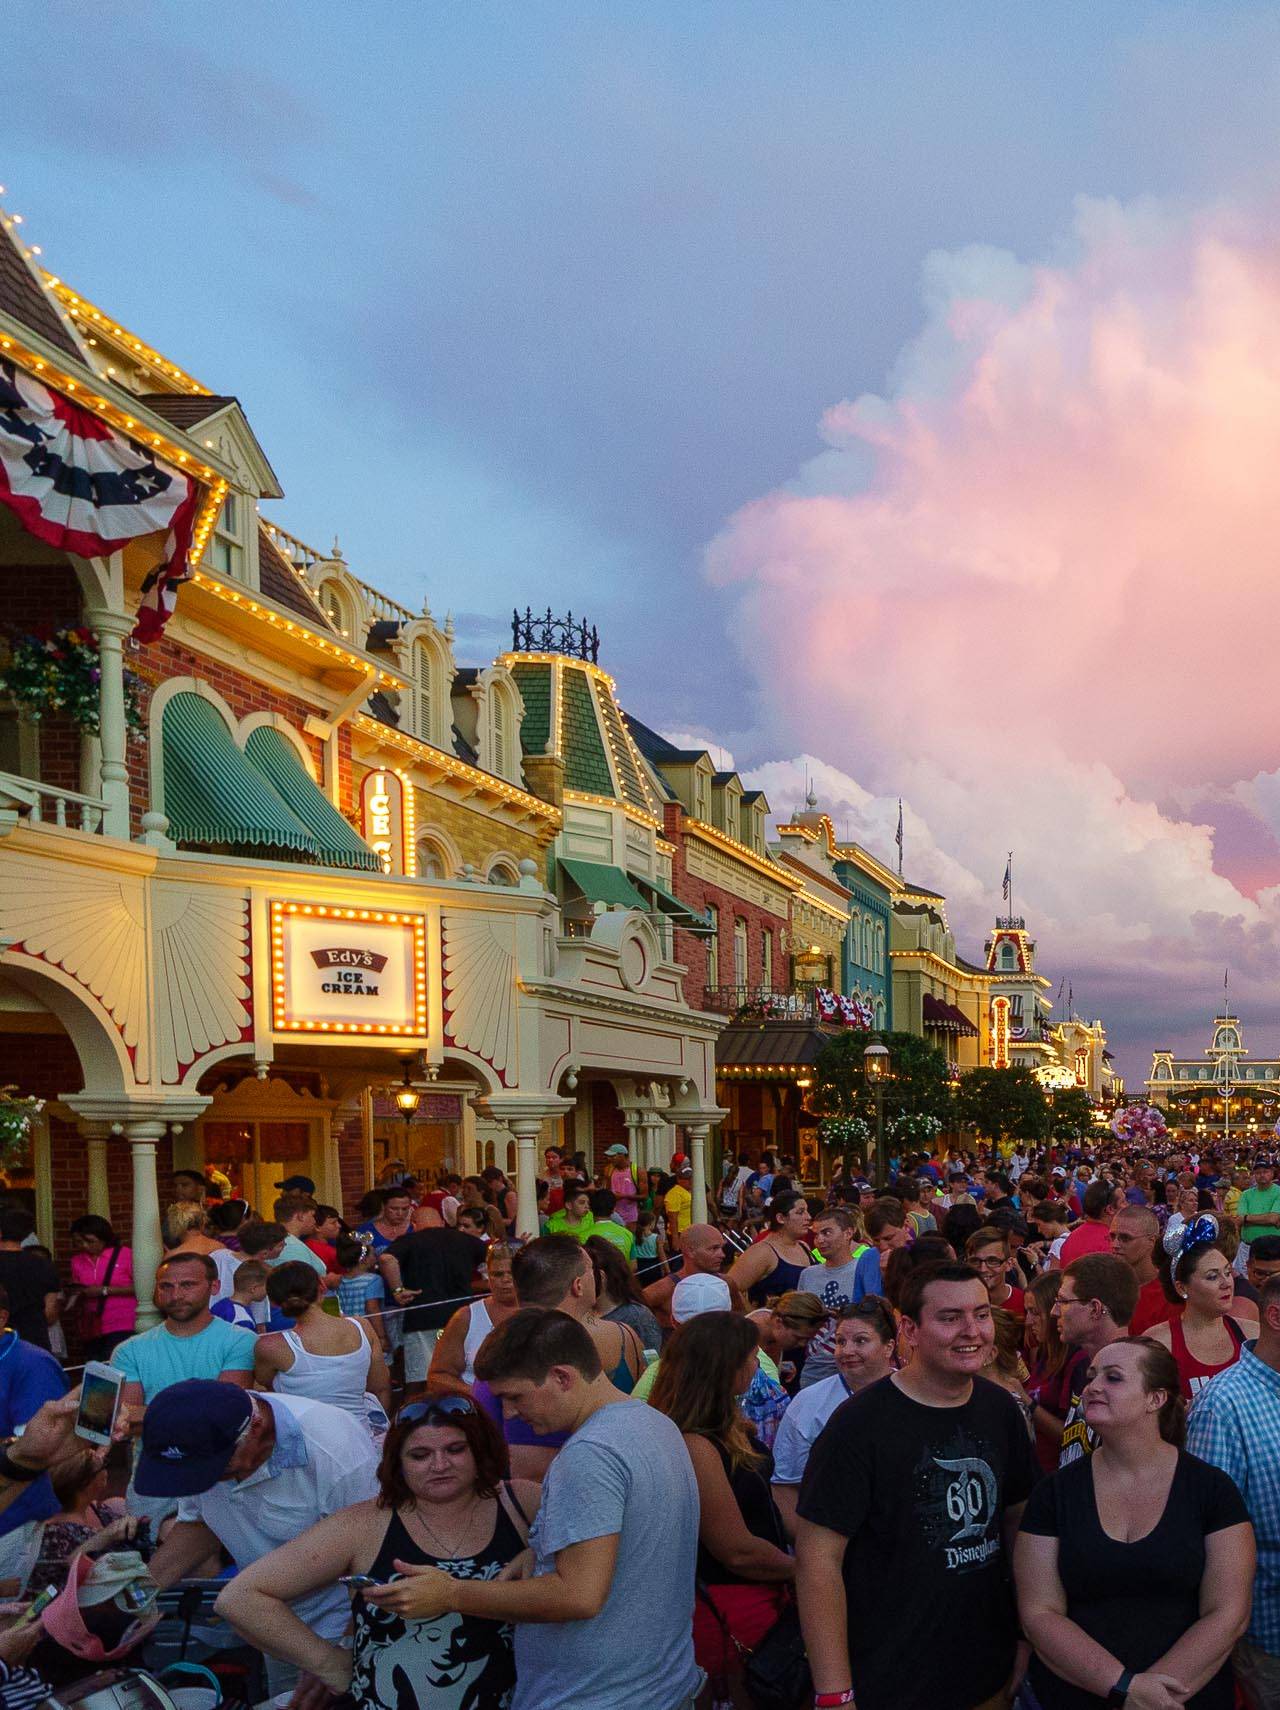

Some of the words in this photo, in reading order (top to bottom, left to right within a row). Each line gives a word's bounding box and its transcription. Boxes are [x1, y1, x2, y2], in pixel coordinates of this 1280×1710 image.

[326, 950, 374, 966] Edy's
[336, 971, 364, 983] ICE
[321, 983, 379, 996] CREAM
[946, 1478, 983, 1521] 60
